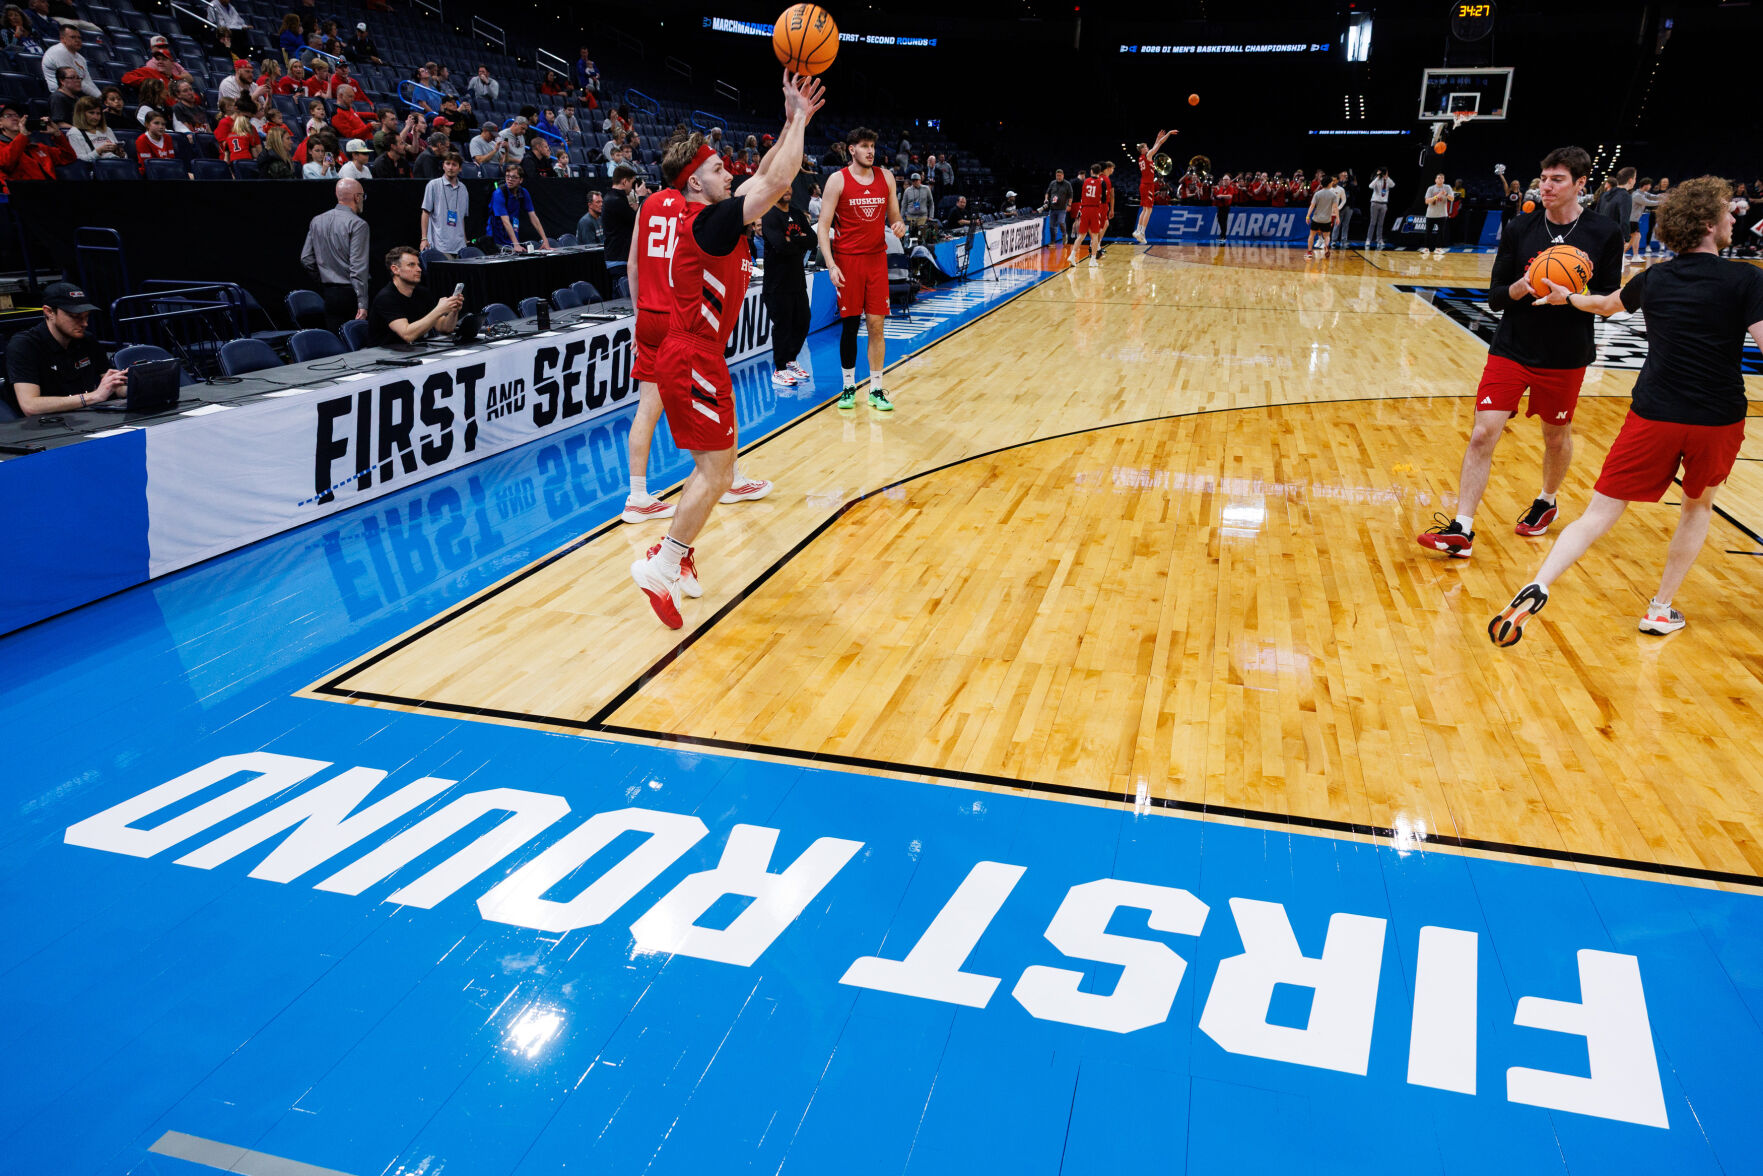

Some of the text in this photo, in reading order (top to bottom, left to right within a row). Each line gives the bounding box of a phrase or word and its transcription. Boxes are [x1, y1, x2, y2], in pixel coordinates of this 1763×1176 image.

[1459, 5, 1489, 17] 34:27
[838, 32, 928, 46] FIRST SECOND ROUNDS
[1172, 45, 1195, 53] MEN'S
[1196, 45, 1244, 53] BASKETBALL
[1244, 44, 1307, 52] CHAMPIONSHIP
[232, 138, 241, 152] 1
[1085, 185, 1097, 198] 31
[849, 197, 886, 206] HUSKERS
[315, 362, 486, 505] FIRST
[487, 378, 526, 422] AND
[533, 329, 641, 428] SECO
[64, 751, 1670, 1129] FIRST ROUND
